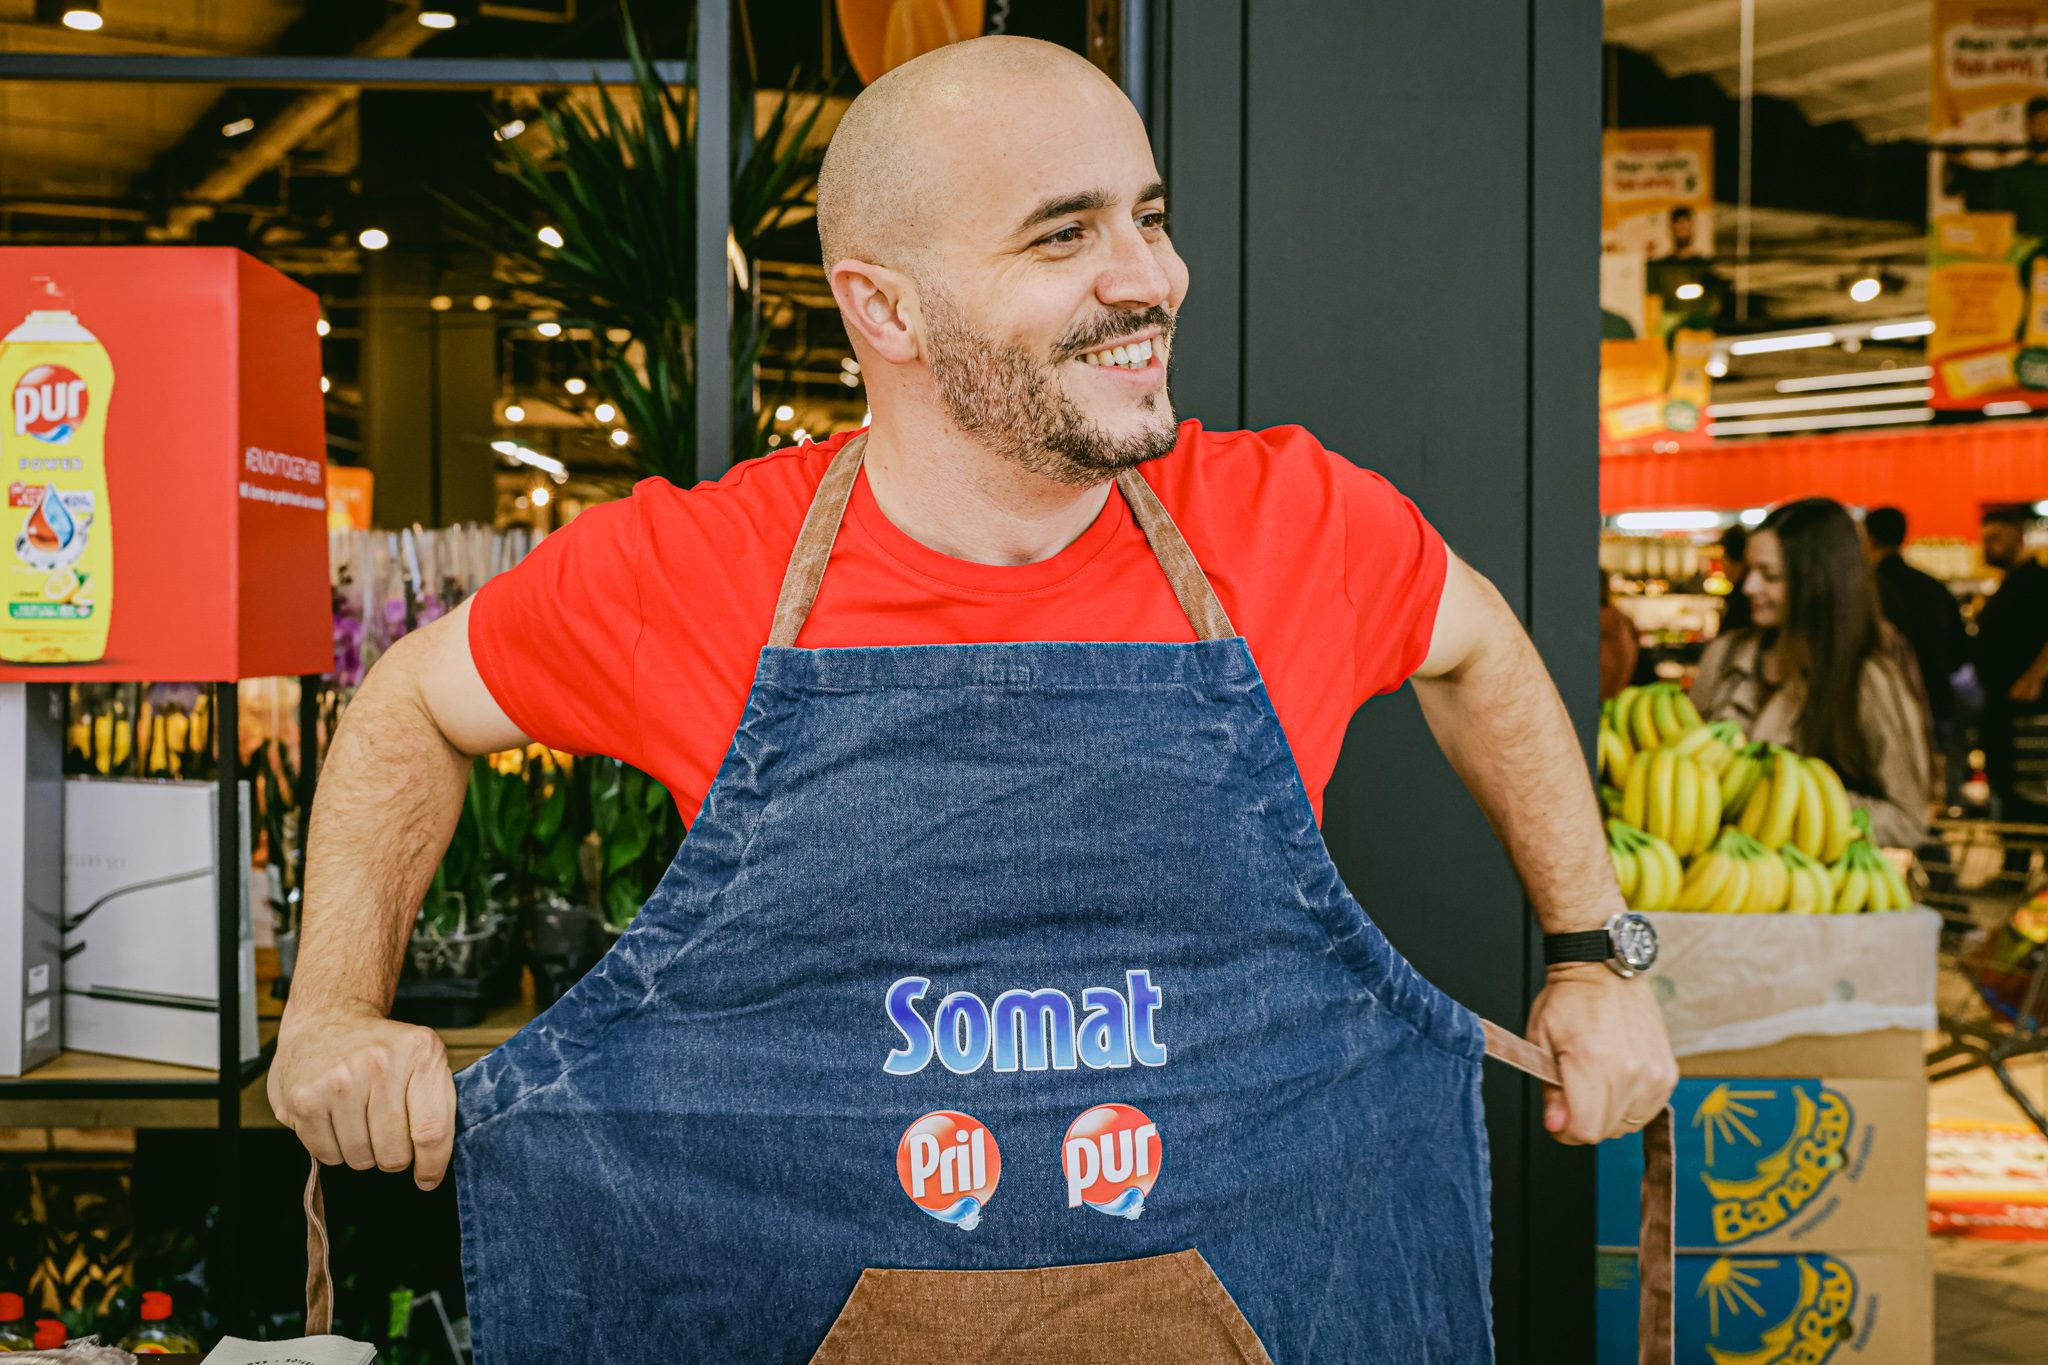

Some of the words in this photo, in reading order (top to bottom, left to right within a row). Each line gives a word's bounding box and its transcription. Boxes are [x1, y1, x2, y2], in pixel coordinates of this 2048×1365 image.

[14, 379, 86, 436] pur
[18, 457, 83, 472] POWER
[883, 969, 1167, 1076] Somat
[909, 1126, 987, 1199] Pril
[1065, 1122, 1157, 1208] pur
